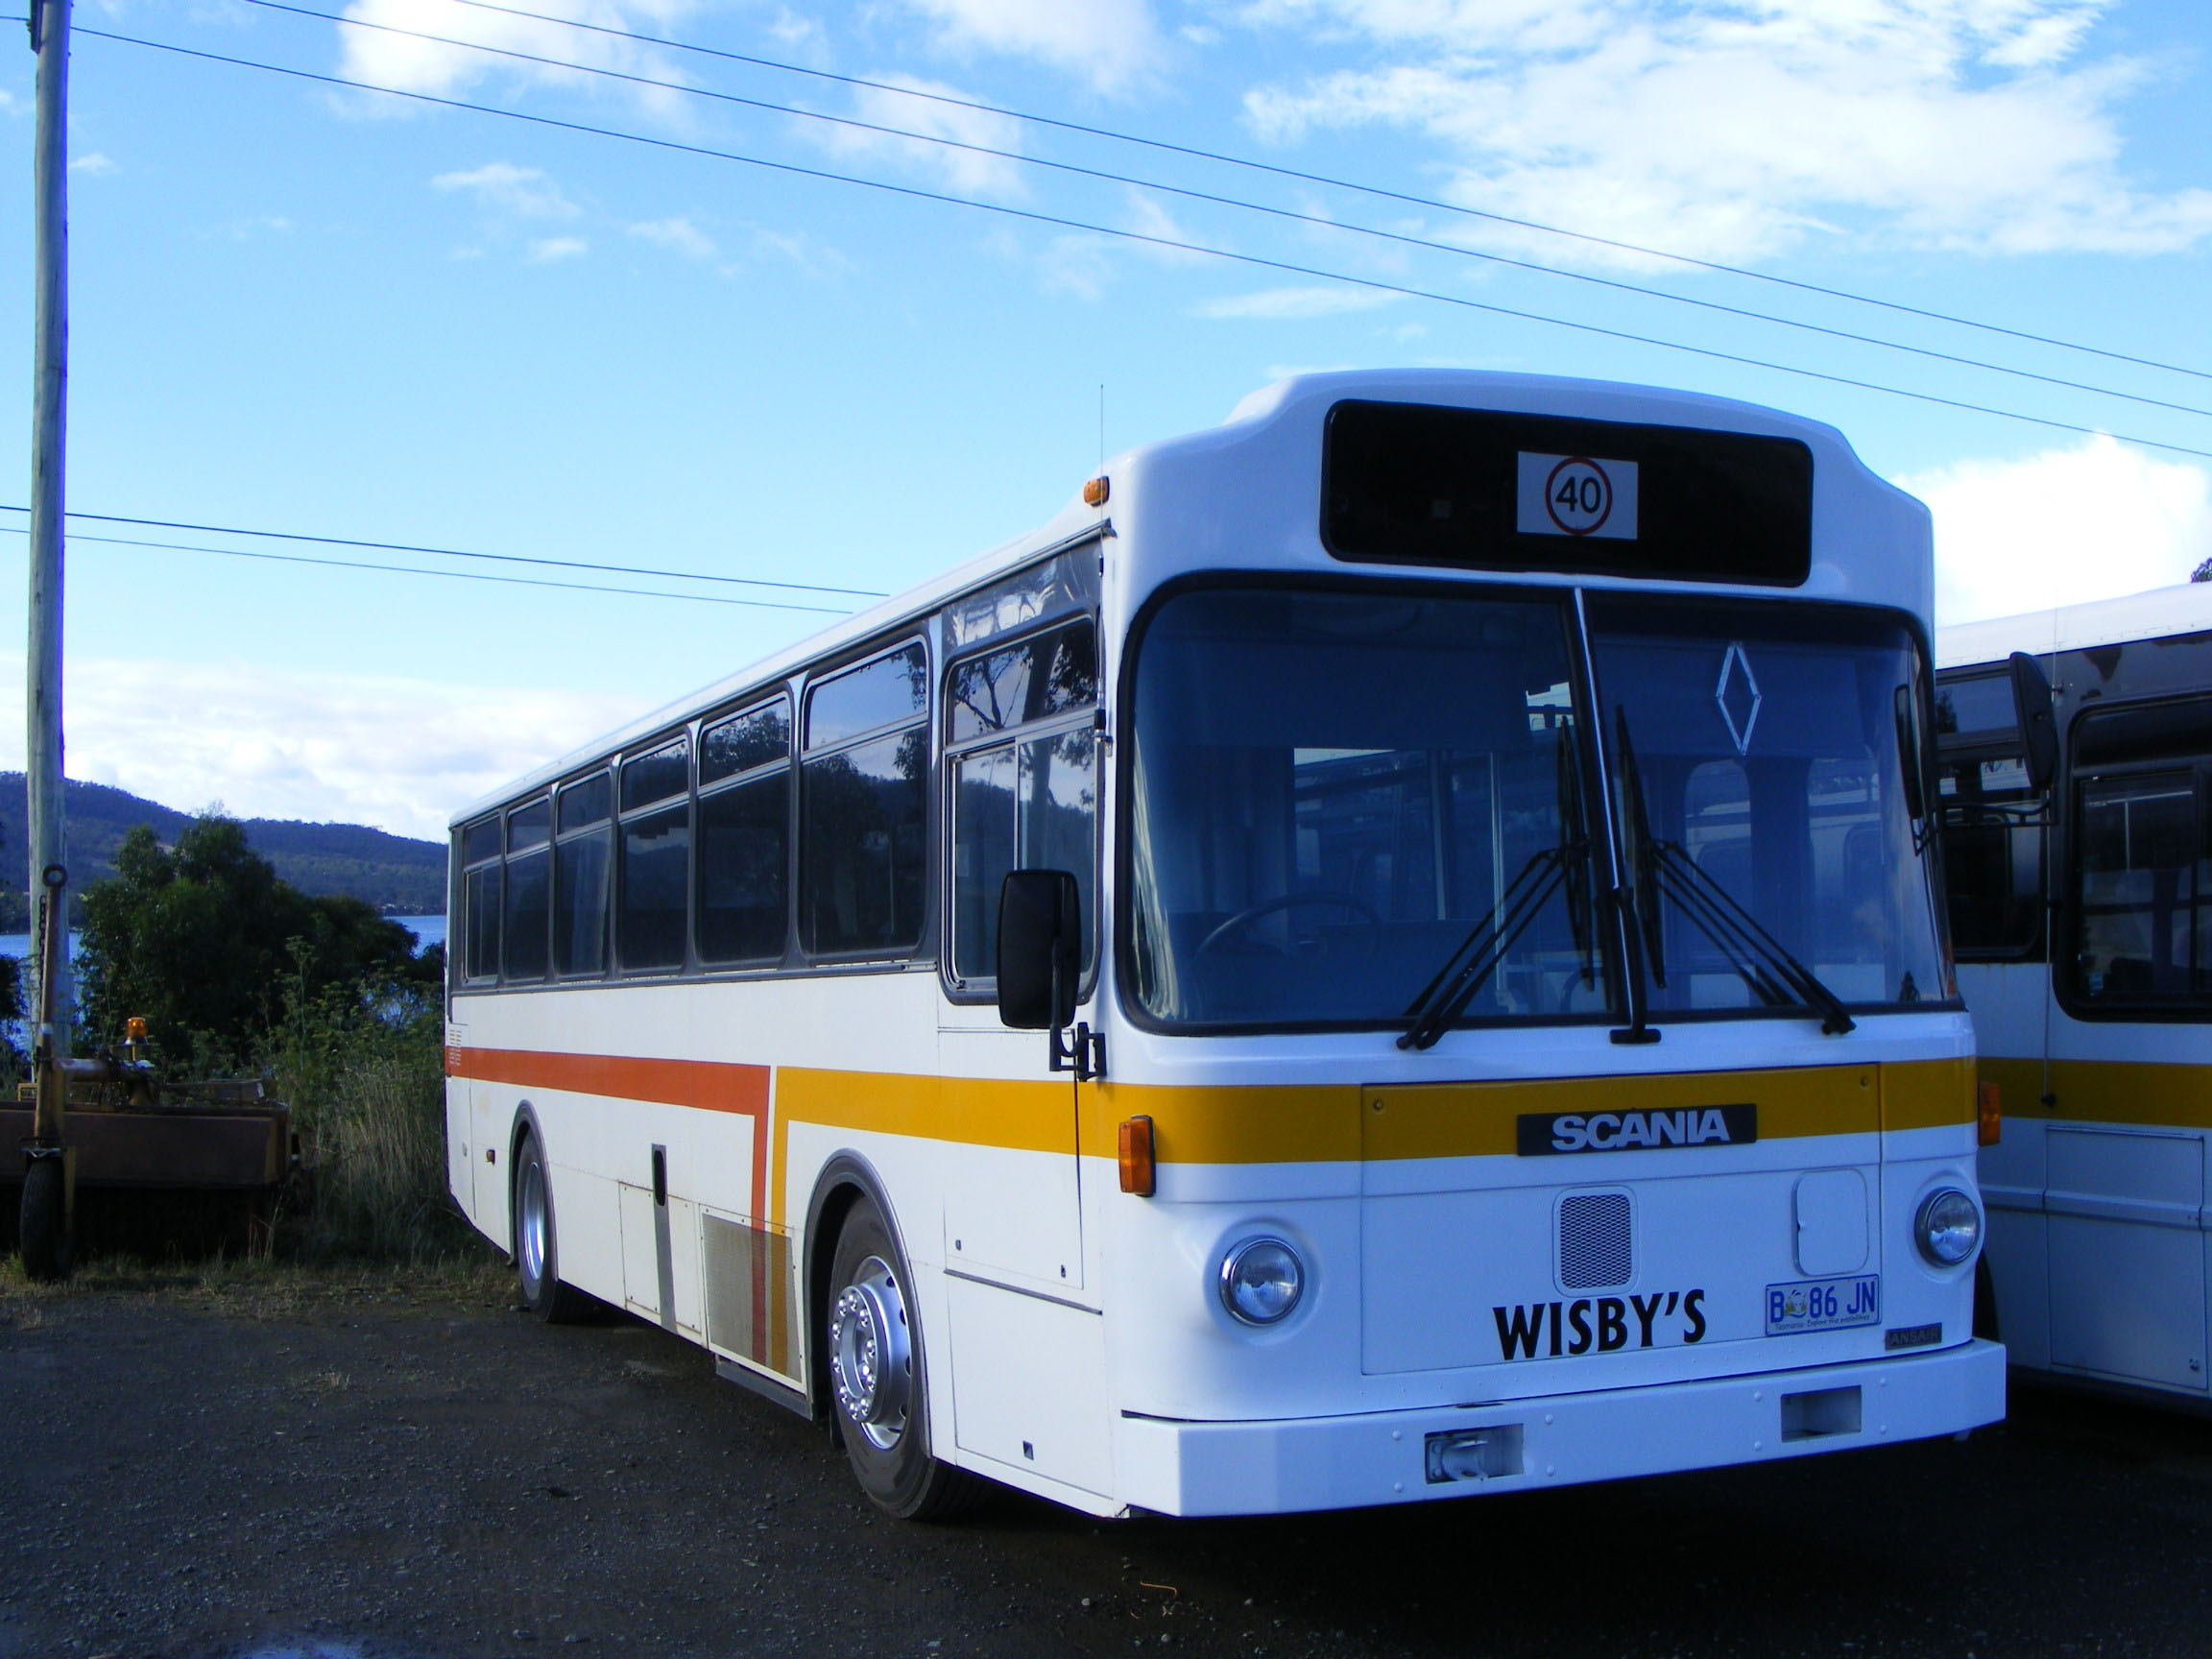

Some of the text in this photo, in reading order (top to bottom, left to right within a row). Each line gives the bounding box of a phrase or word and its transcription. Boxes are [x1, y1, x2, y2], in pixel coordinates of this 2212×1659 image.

[1555, 475, 1601, 514] 40
[1551, 1109, 1730, 1151] SCANIA
[1810, 1286, 1838, 1318] 86
[1846, 1281, 1875, 1313] JN
[1492, 1288, 1706, 1360] WISBY'S
